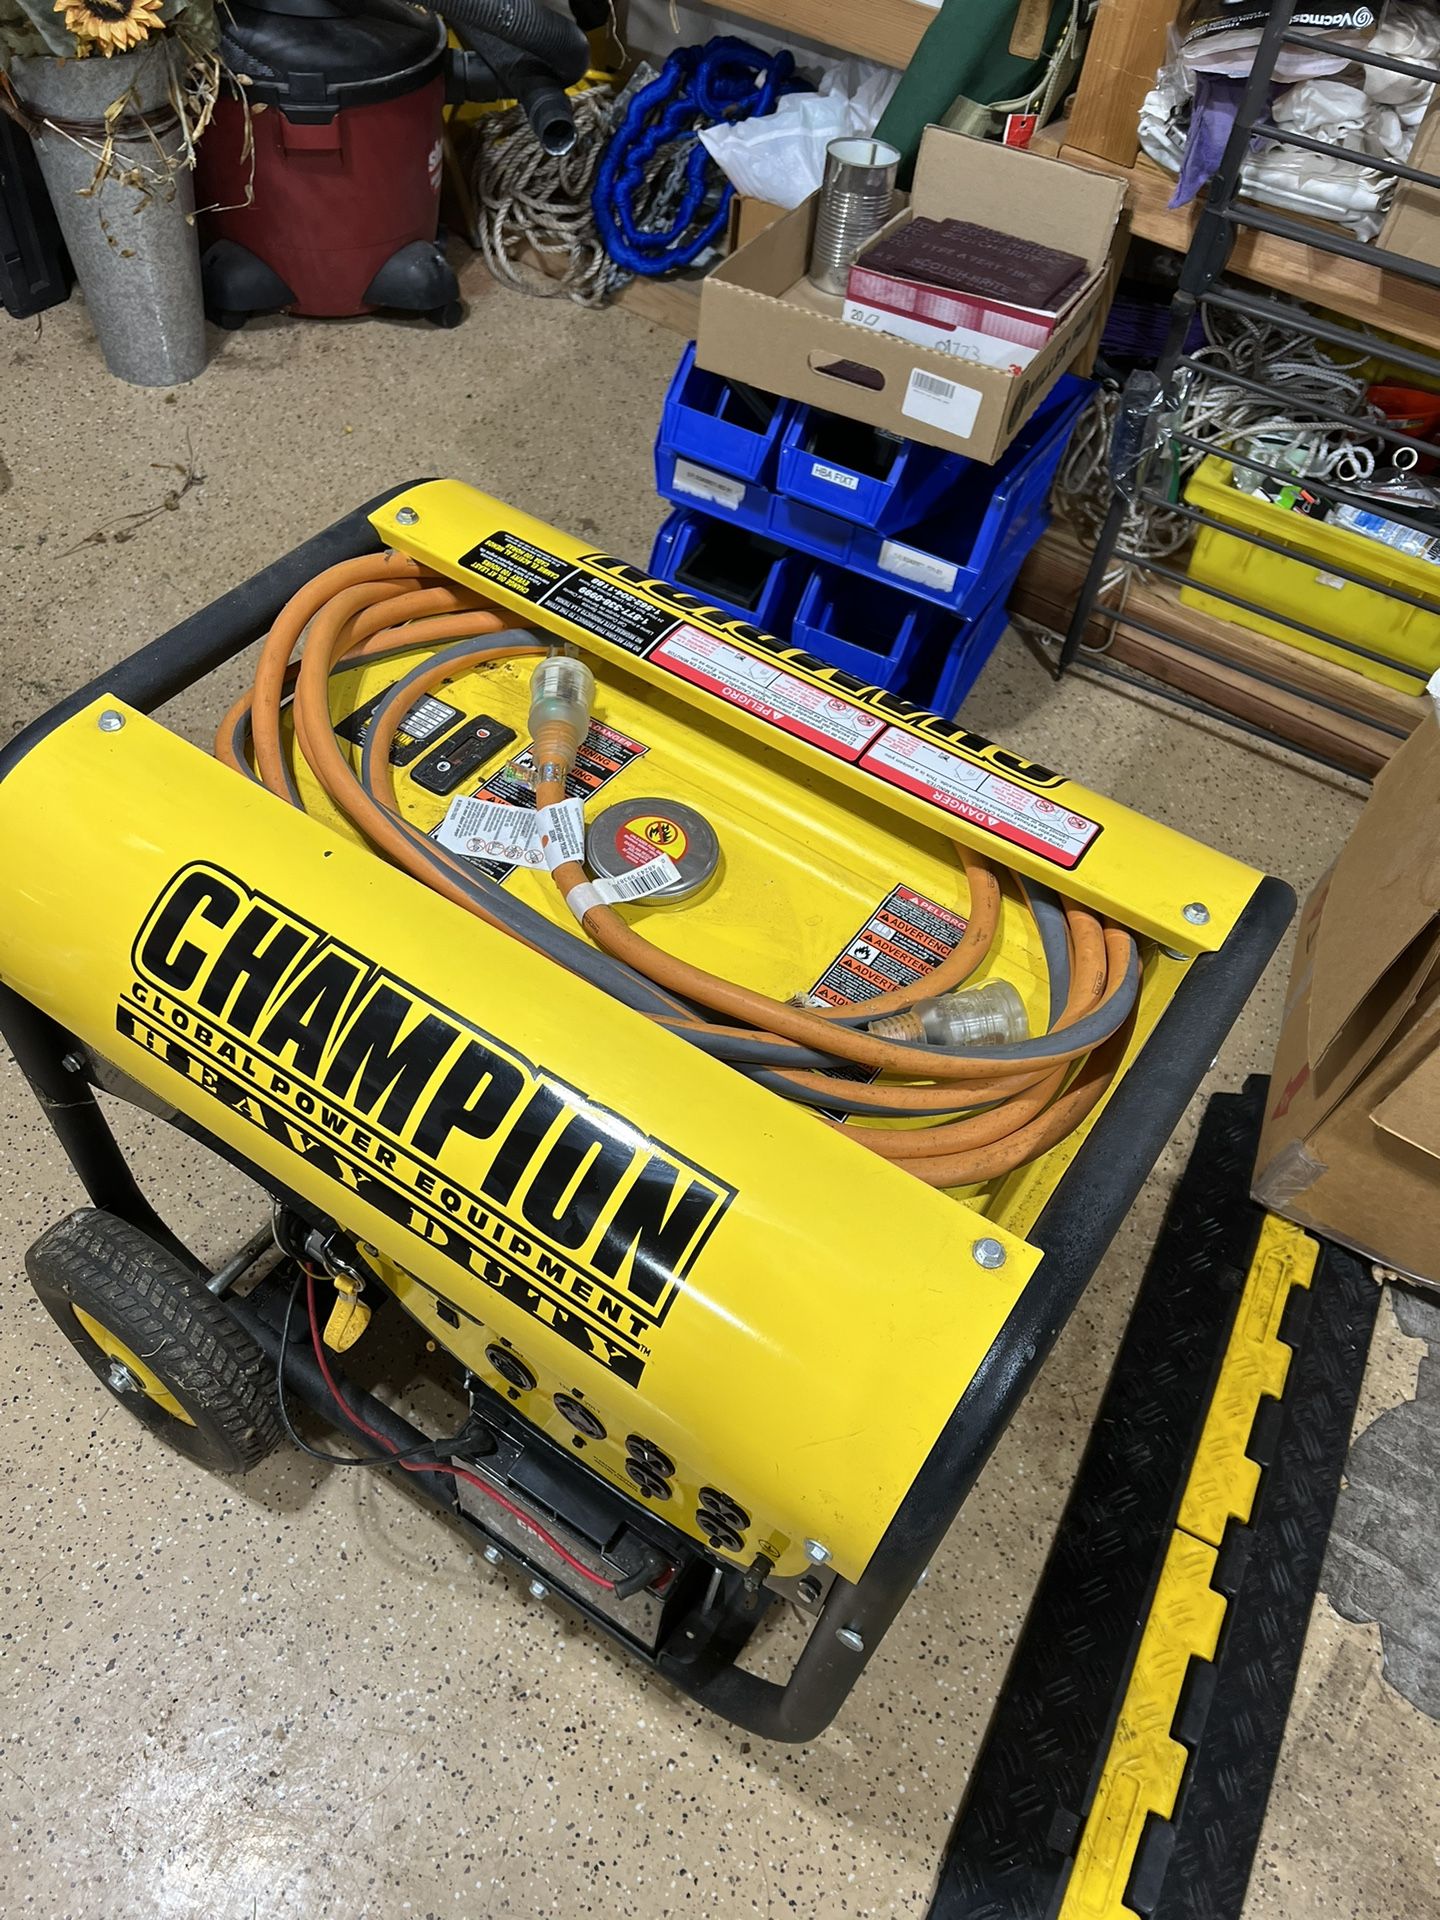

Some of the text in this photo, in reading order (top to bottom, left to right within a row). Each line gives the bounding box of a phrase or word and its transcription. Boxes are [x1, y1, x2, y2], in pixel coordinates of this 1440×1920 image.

[1289, 12, 1352, 30] Vacmas
[913, 257, 1009, 292] SCOTCH-BRITE
[851, 309, 864, 321] 20
[469, 561, 490, 573] LEAST
[494, 574, 508, 582] OIL
[503, 578, 530, 593] CHANGE
[589, 577, 662, 615] 1-562-204-1188
[577, 585, 650, 625] 1-877-338-0999
[720, 686, 772, 715] PELIGRO
[594, 722, 633, 748] DANGER
[578, 745, 612, 767] ARNING
[931, 790, 986, 821] DANGER
[636, 864, 656, 876] 48243
[919, 898, 967, 931] PELIGRO
[889, 917, 952, 956] ADVERTENCI
[873, 938, 933, 975] ADVERTENC
[140, 868, 724, 1310] CHAMPION
[131, 982, 651, 1337] GLOBAL POWER EQUIPMENT
[130, 1017, 628, 1368] HEAVY DUTY
